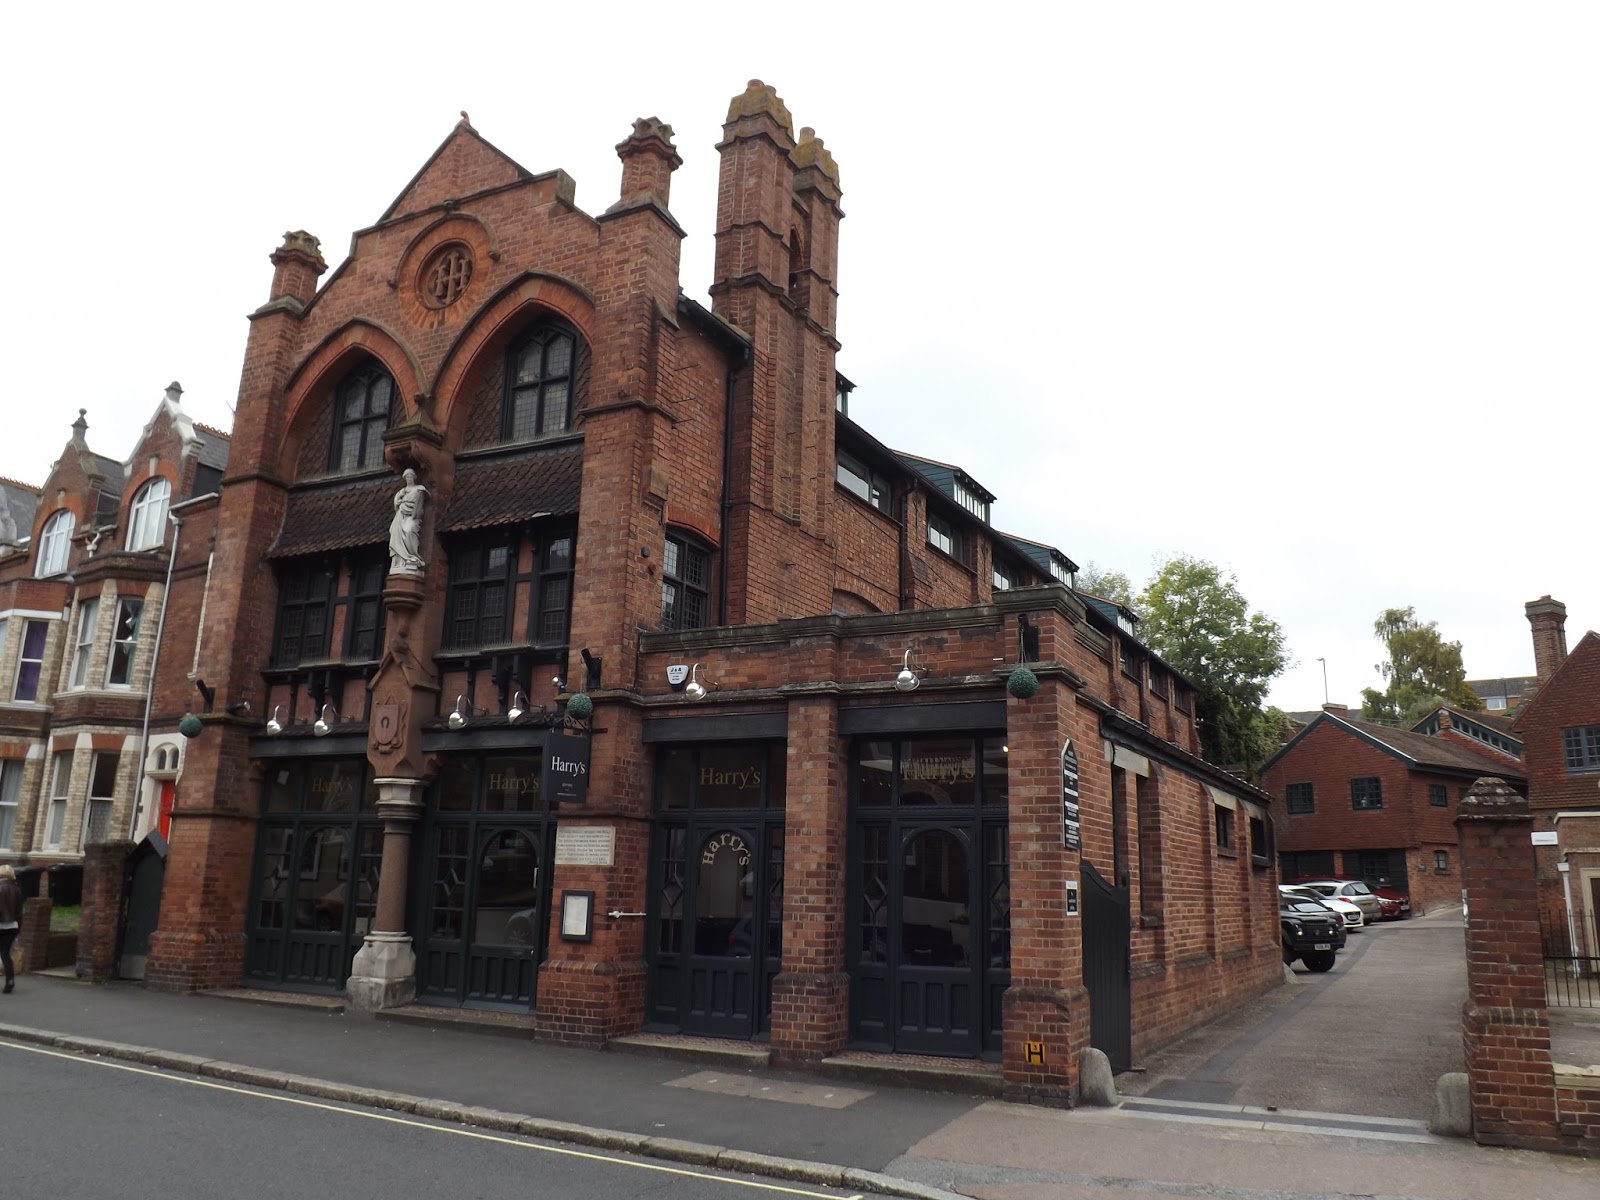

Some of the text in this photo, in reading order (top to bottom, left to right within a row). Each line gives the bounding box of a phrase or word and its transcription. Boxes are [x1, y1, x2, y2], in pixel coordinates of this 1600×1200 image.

[551, 756, 586, 777] Harry's
[700, 766, 761, 789] Harry's
[489, 773, 539, 795] Harry's
[702, 833, 751, 866] Harry's
[1027, 1043, 1044, 1063] H
